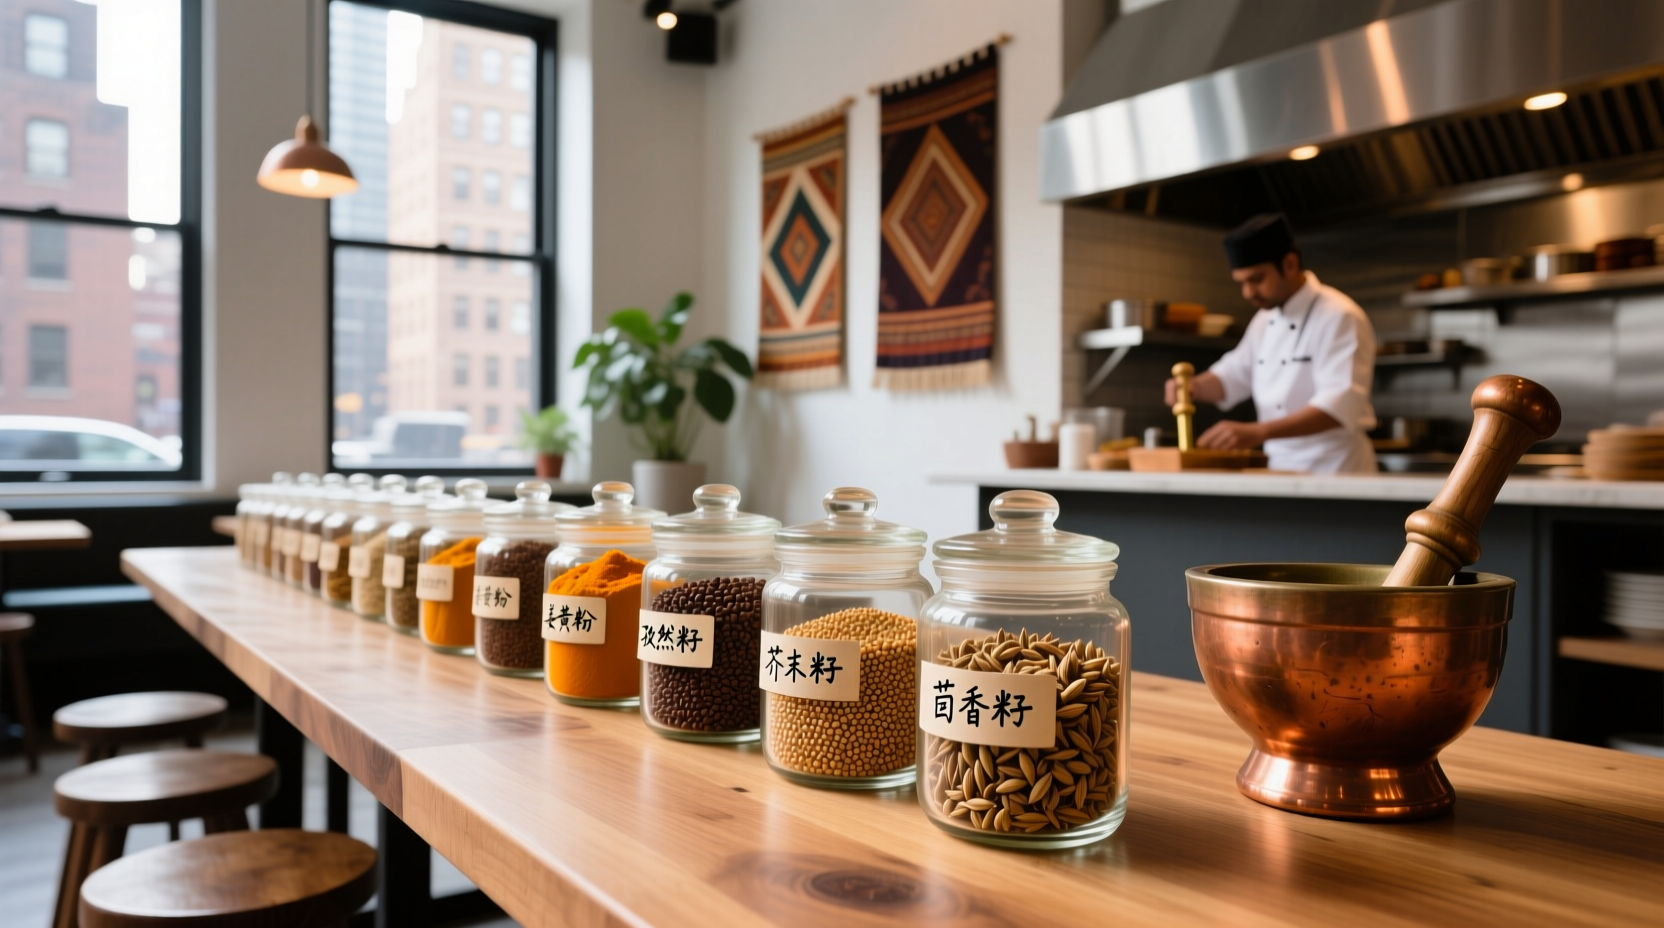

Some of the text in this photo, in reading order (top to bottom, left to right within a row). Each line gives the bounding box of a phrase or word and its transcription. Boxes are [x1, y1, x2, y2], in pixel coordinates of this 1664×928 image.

[544, 604, 597, 632] 姜黄粉
[641, 624, 703, 653] 孜然籽
[765, 645, 843, 684] 芥末籽
[933, 679, 1033, 727] 茴香籽
